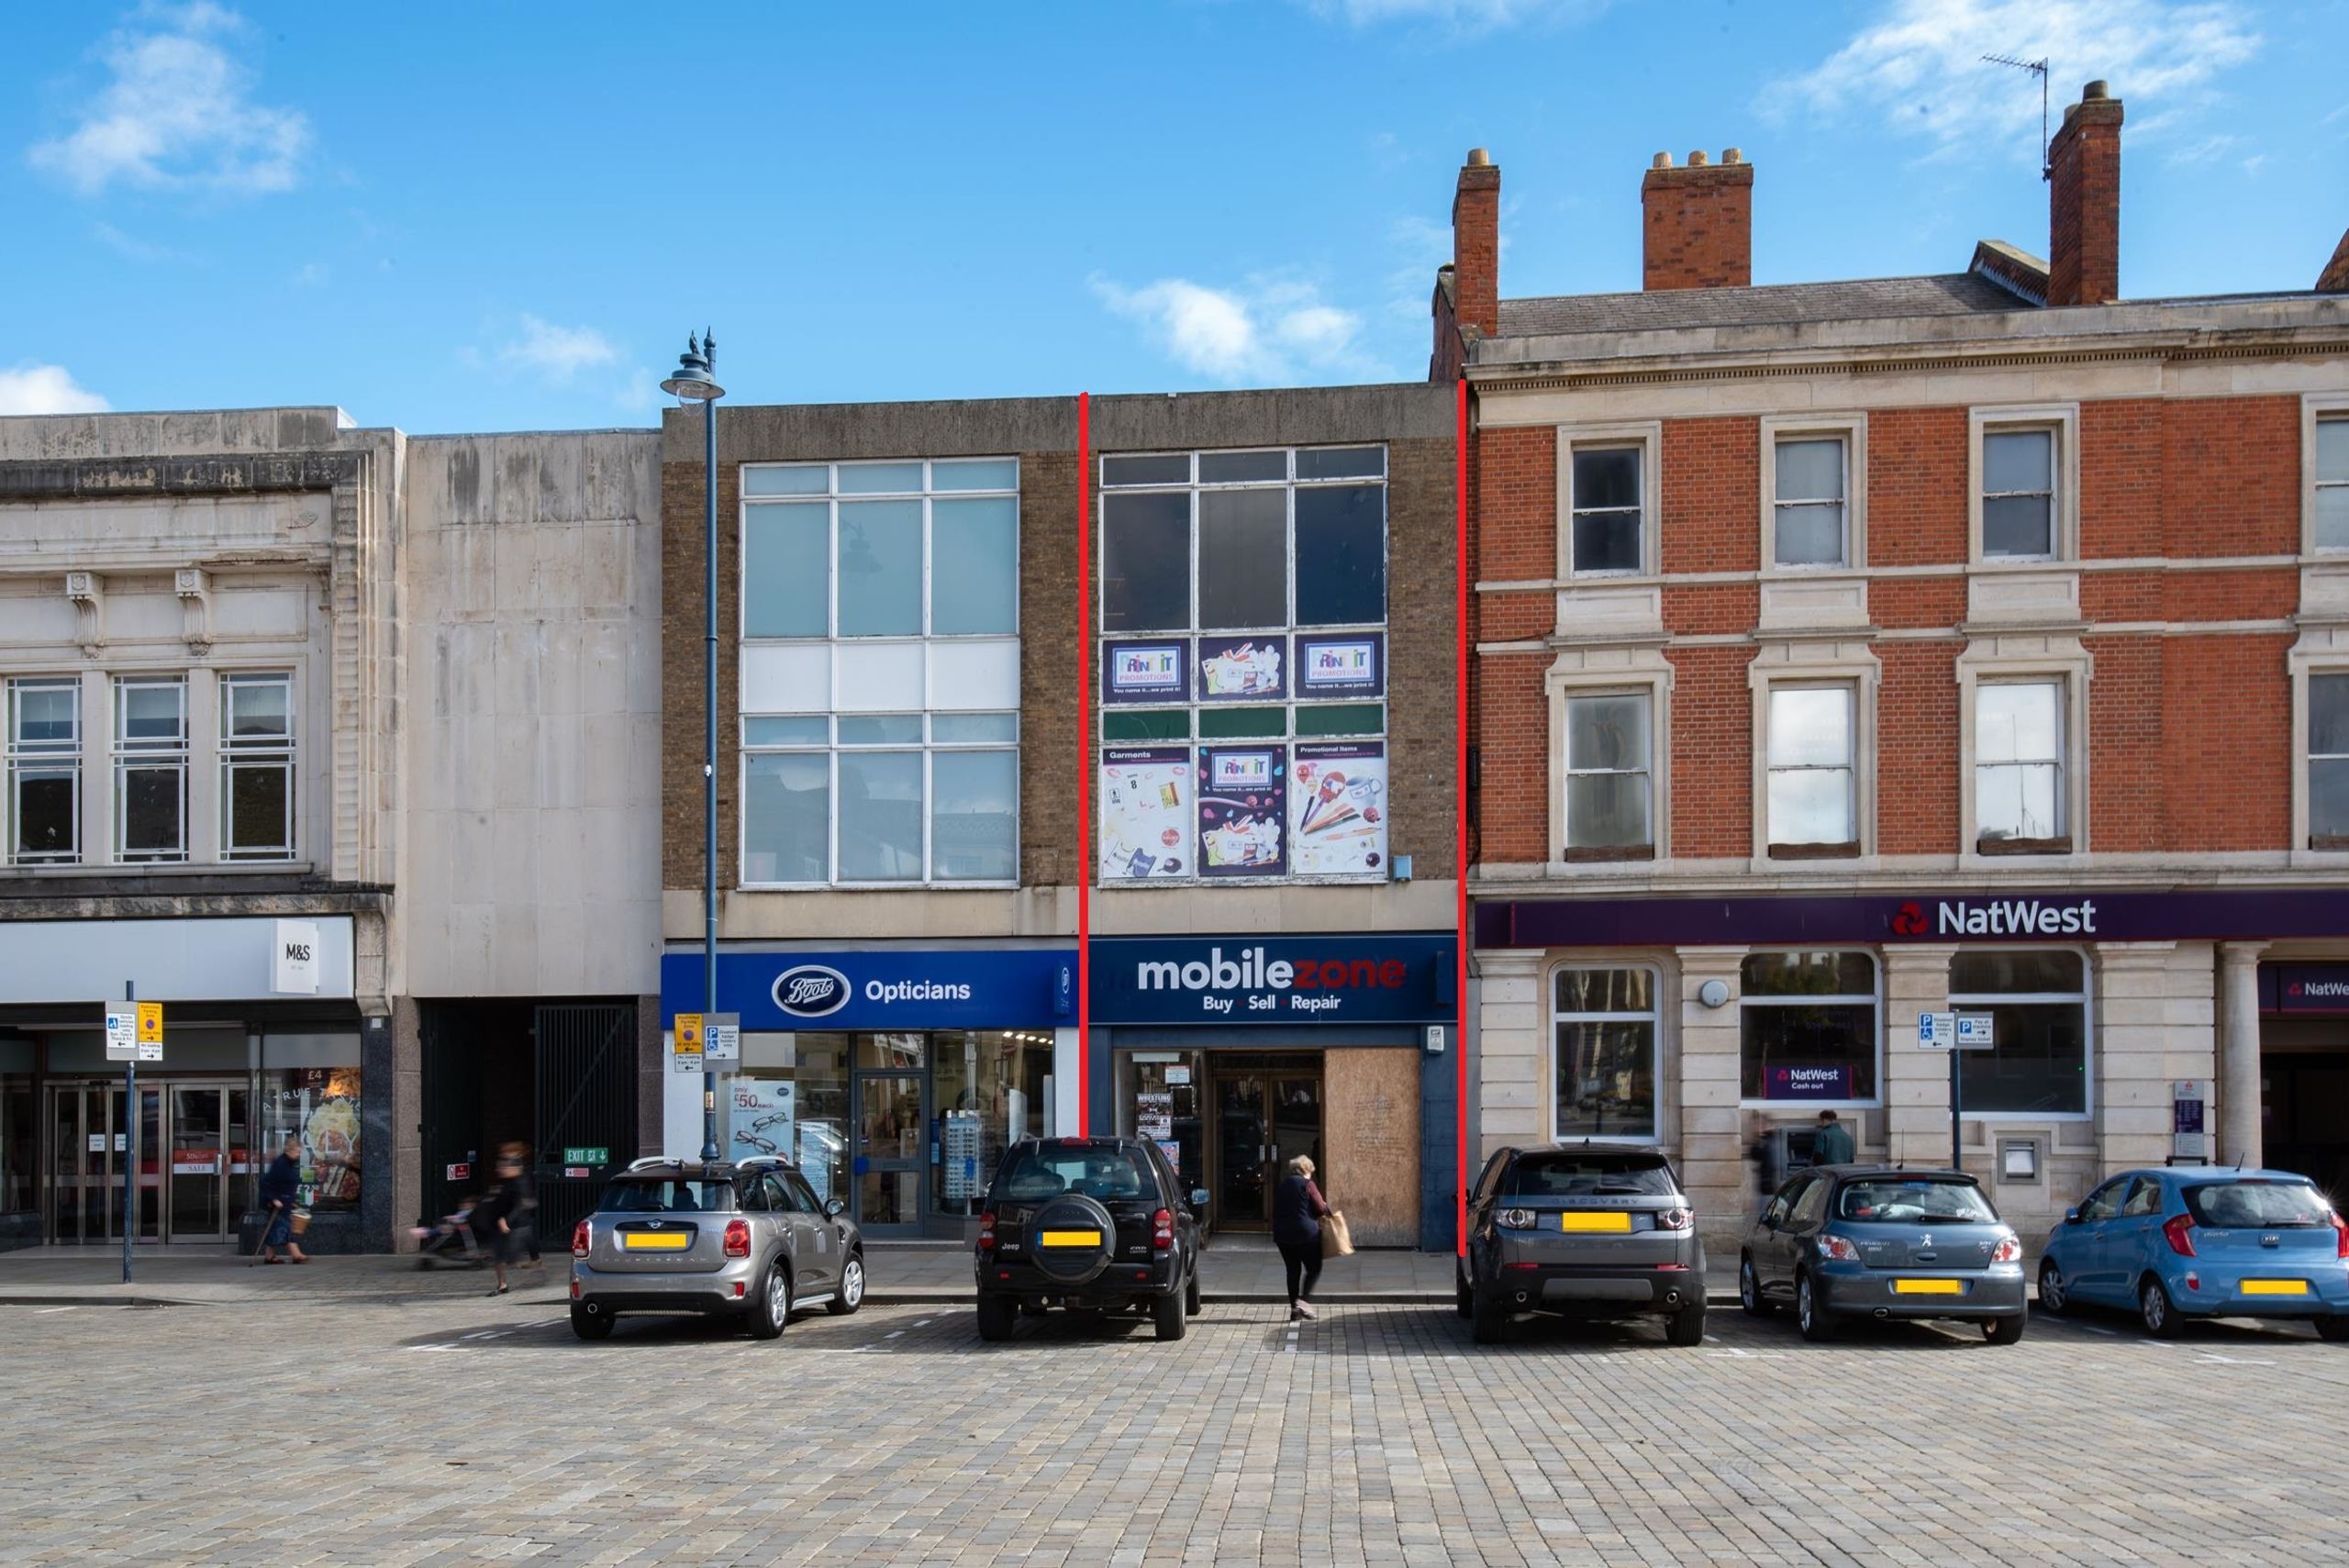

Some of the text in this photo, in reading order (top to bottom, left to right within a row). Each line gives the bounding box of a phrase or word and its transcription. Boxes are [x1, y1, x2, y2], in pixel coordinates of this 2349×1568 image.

[1119, 673, 1174, 682] PROMOTIONS
[1109, 751, 1152, 759] Garments
[1938, 899, 2097, 935] NatWest
[285, 942, 311, 962] M&S
[1137, 946, 1407, 990] mobilezone
[784, 977, 835, 1004] Boots
[865, 979, 971, 1004] Opticians
[1203, 995, 1341, 1014] Buy Sell Repair
[1922, 1015, 1931, 1026] P
[709, 1028, 717, 1038] P
[1962, 1022, 1970, 1032] P
[307, 1071, 322, 1080] £4
[1791, 1069, 1839, 1081] NatWest
[734, 1094, 758, 1108] £50
[1137, 1094, 1172, 1102] WRESTLING
[567, 1150, 584, 1162] EXIT
